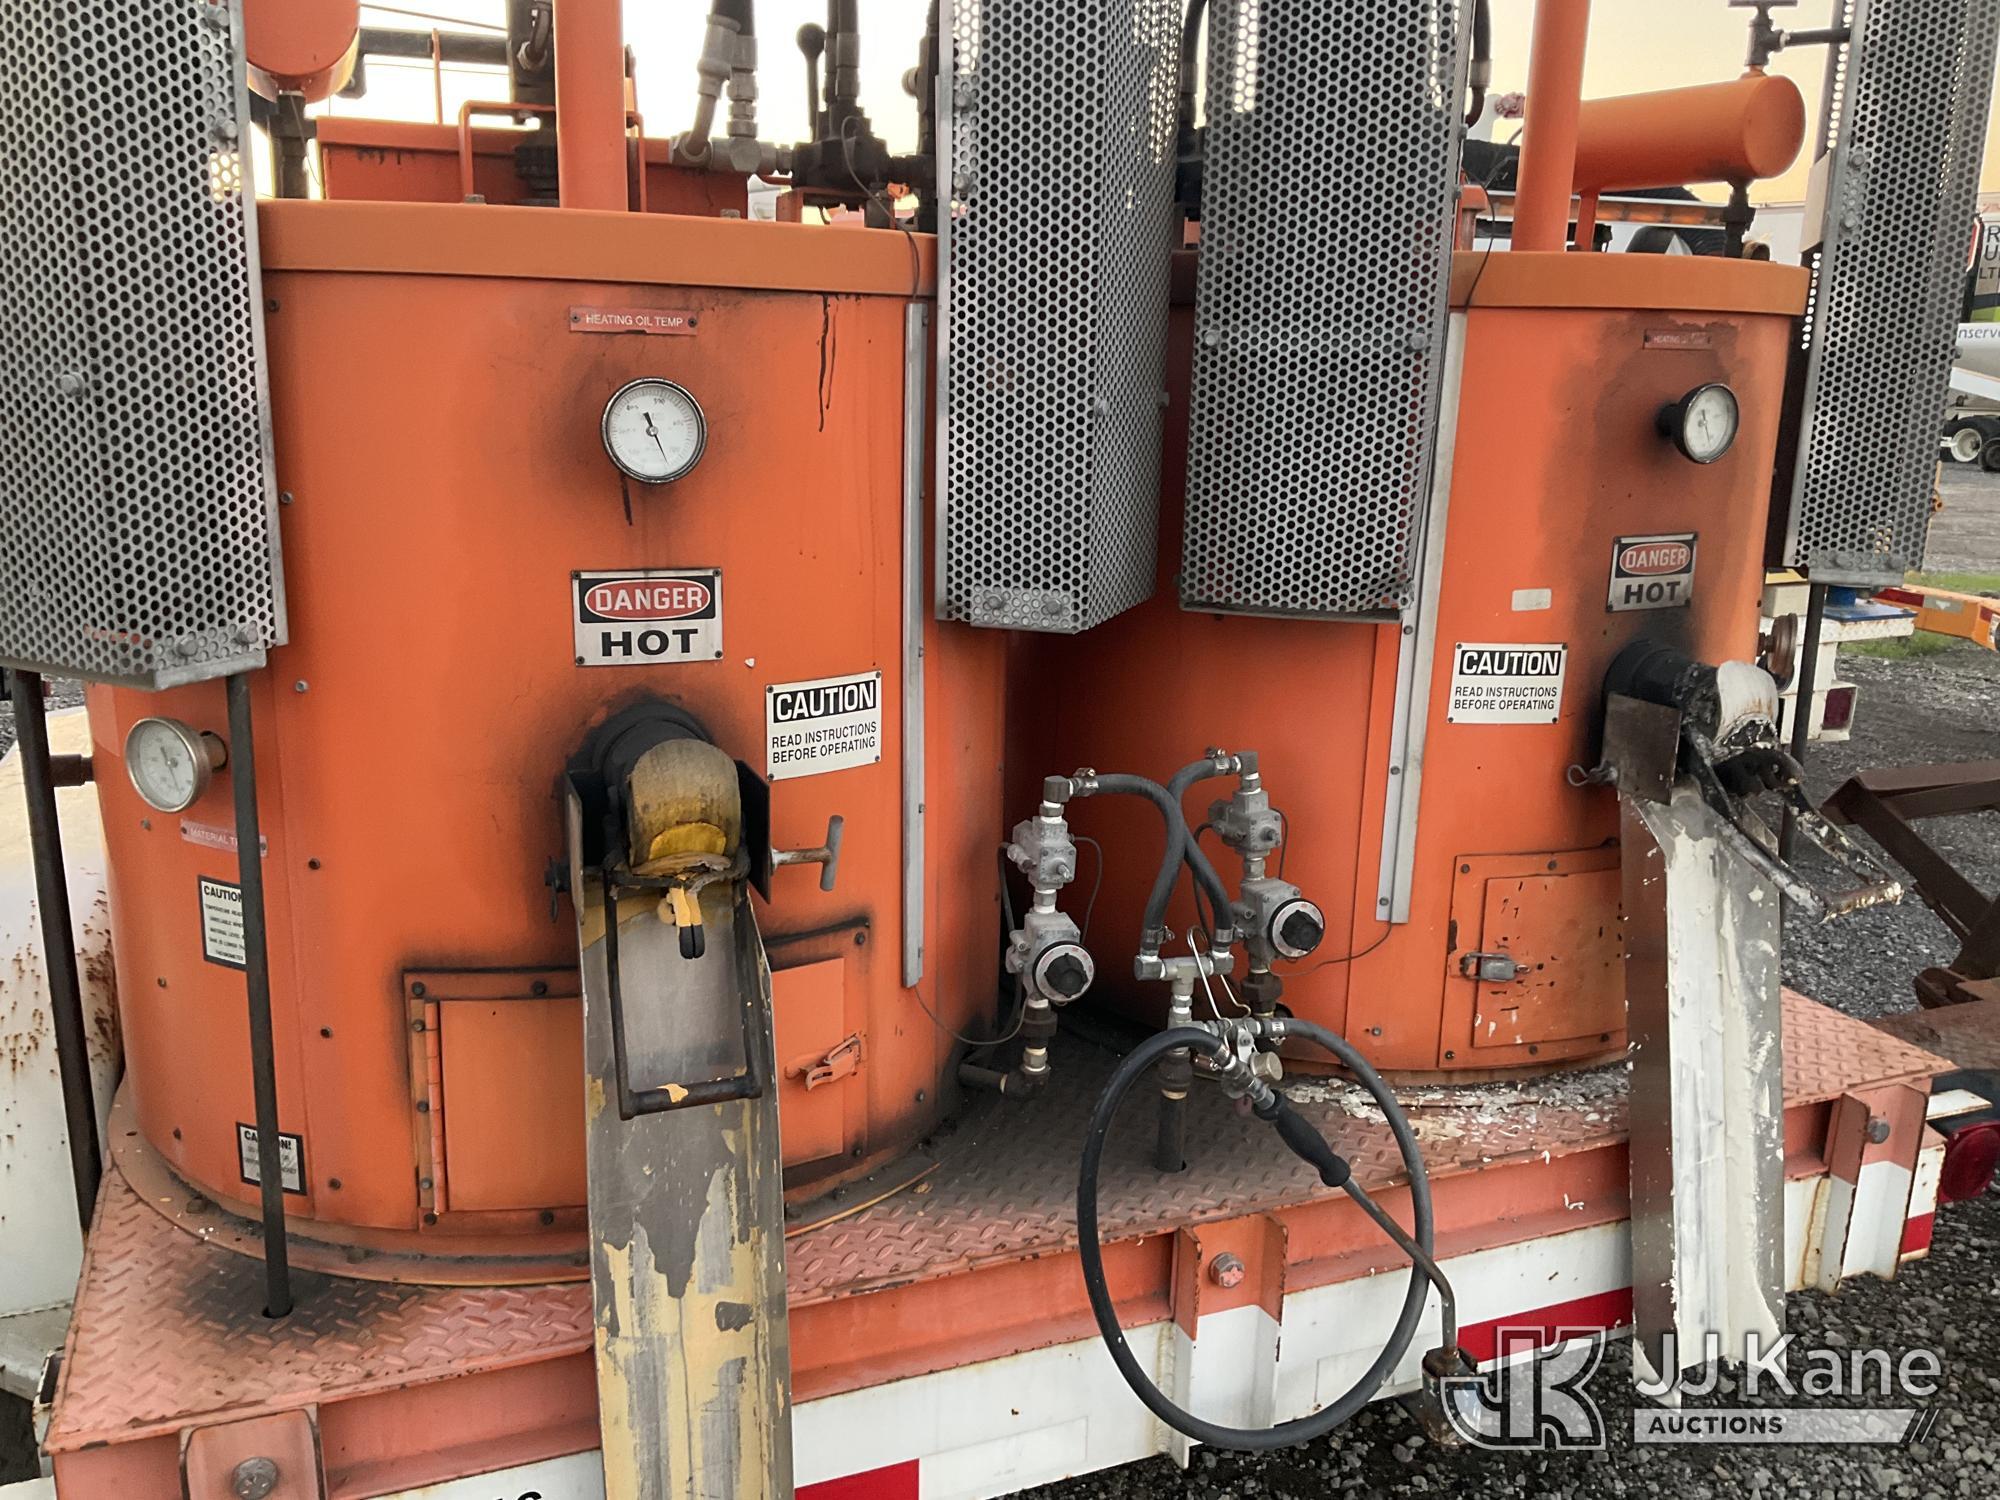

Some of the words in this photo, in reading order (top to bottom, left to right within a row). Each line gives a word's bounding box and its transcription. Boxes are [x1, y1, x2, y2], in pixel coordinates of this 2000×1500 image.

[1979, 267, 2000, 279] LT
[586, 314, 633, 326] HEATING
[635, 315, 652, 326] OIL
[654, 317, 683, 327] TEMP
[1958, 328, 2000, 339] nserv
[1625, 548, 1687, 569] DANGER
[595, 586, 703, 611] DANGER
[1624, 581, 1681, 604] HOT
[601, 628, 698, 657] HOT
[1462, 651, 1559, 675] CAUTION
[776, 681, 875, 721] CAUTION
[1455, 686, 1483, 697] READ
[1486, 687, 1557, 697] INSTRUCTIONS
[1454, 699, 1496, 710] BEFORE
[1498, 699, 1555, 710] OPERATING
[772, 733, 802, 748] READ
[805, 721, 877, 743] INSTRUCTIONS
[772, 746, 817, 763] BEFORE
[820, 736, 876, 757] OPERATING
[190, 827, 229, 845] MATERIAL
